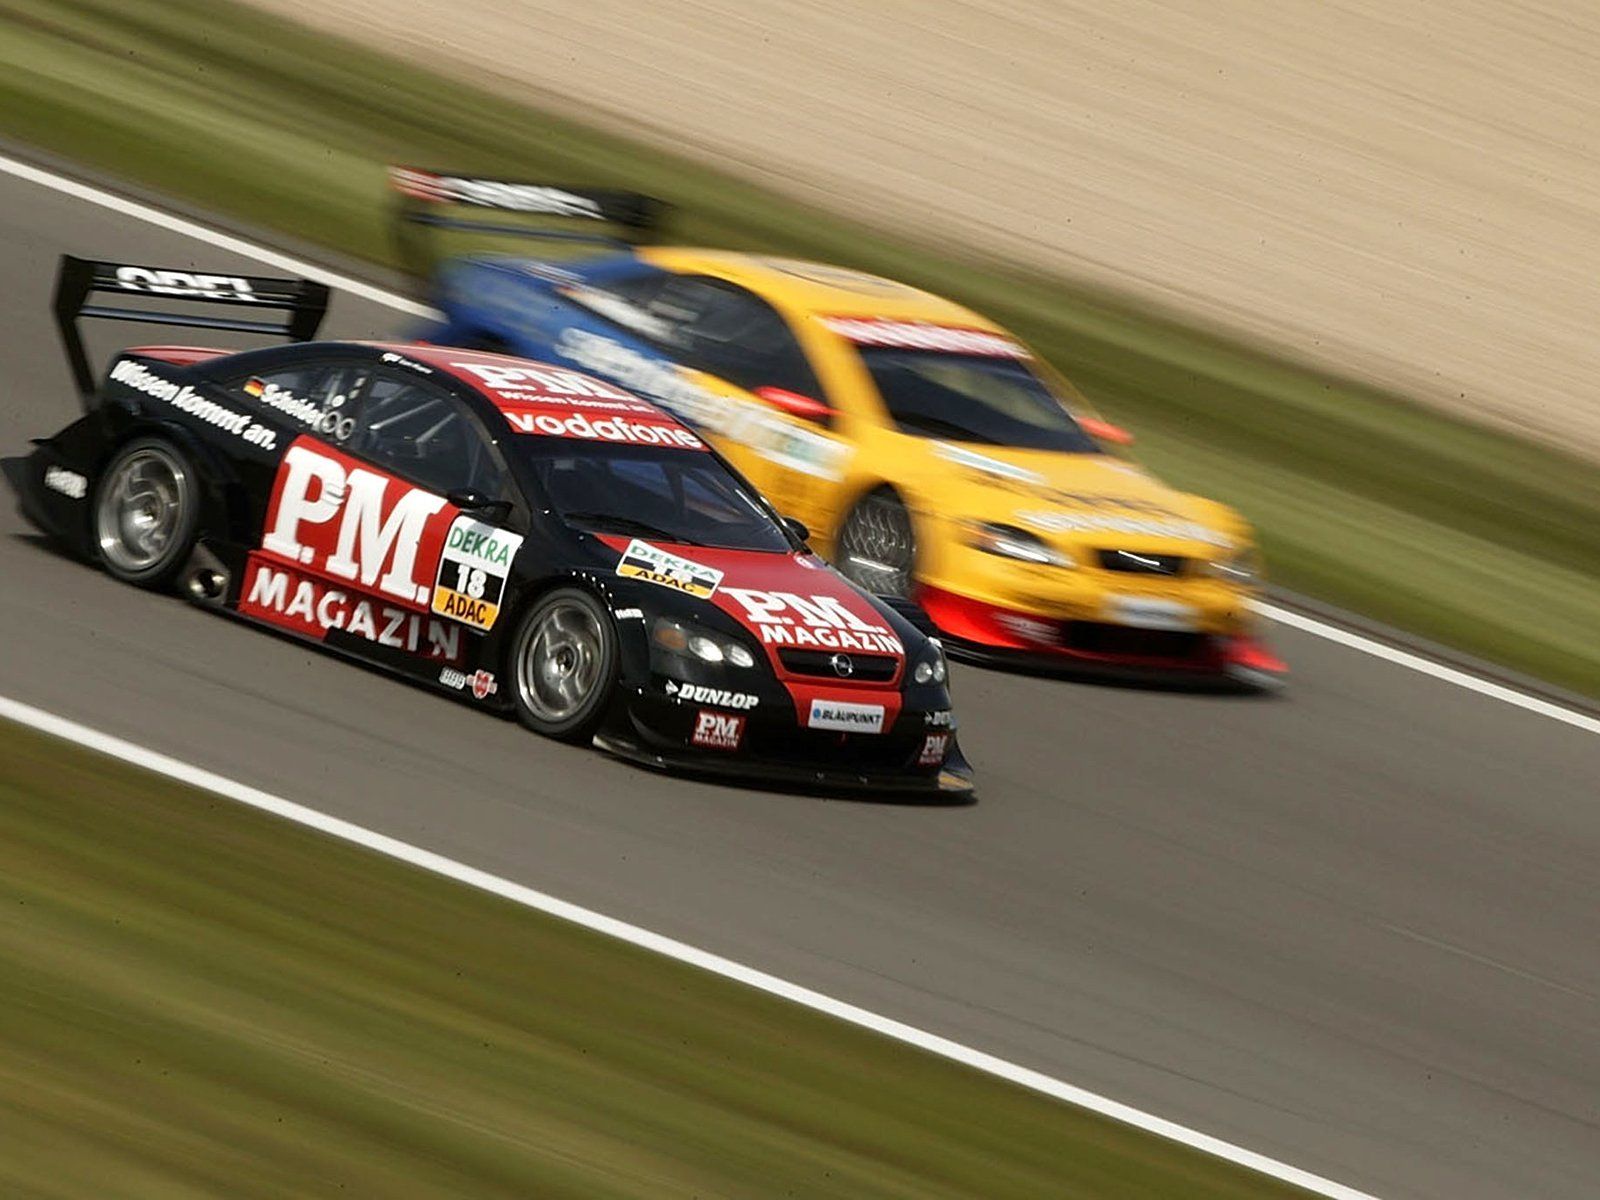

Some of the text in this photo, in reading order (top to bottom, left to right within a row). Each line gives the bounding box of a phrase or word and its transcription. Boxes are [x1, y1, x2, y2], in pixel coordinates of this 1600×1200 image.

[171, 386, 252, 435] kommt
[242, 424, 277, 450] an.
[502, 411, 703, 449] vodafone
[262, 446, 449, 605] P.M.
[448, 526, 509, 567] DEKRA
[630, 545, 717, 580] DEKRA
[456, 563, 487, 599] 18
[635, 570, 697, 593] ADAC
[247, 566, 461, 661] MAGAZIN
[444, 593, 487, 624] ADAC
[718, 586, 888, 635] P.M.
[760, 623, 905, 655] MAGAZIN
[678, 683, 760, 710] DUNLOP
[822, 708, 882, 725] BLAUPUNKT
